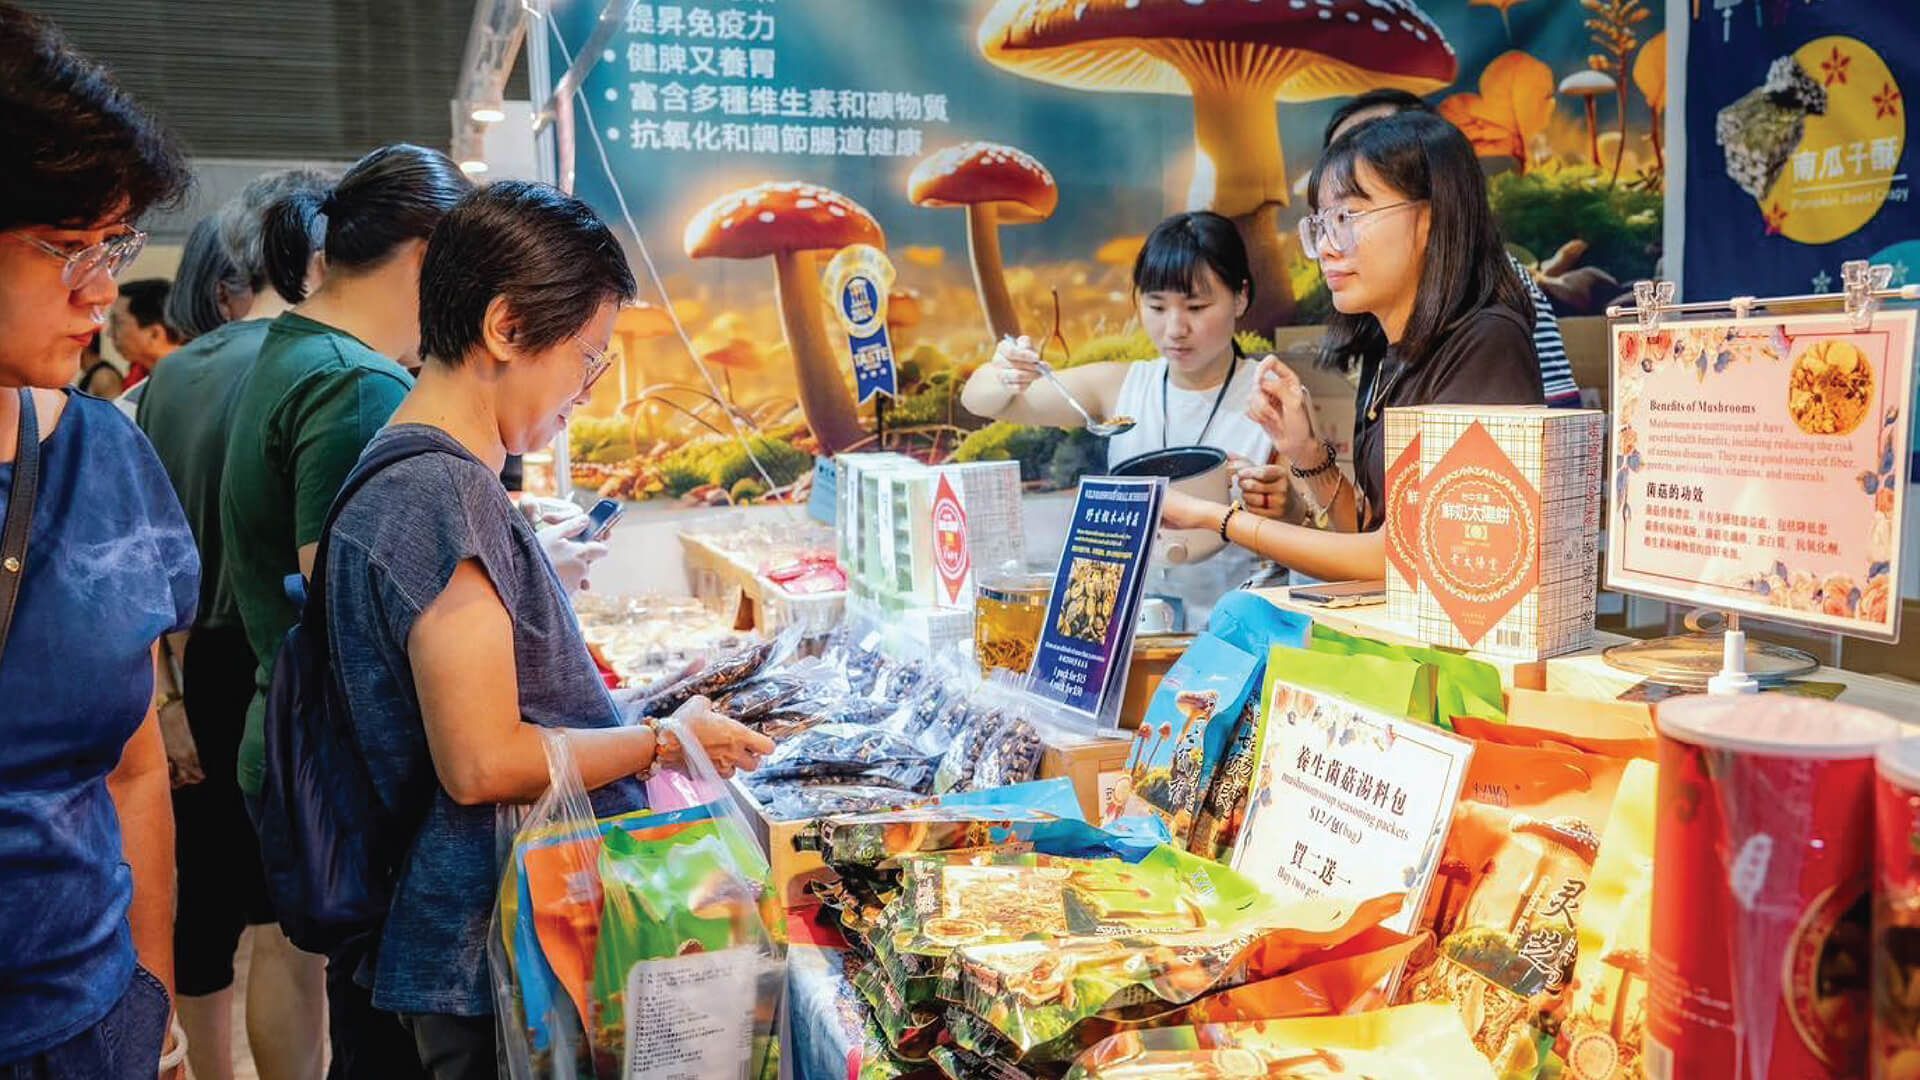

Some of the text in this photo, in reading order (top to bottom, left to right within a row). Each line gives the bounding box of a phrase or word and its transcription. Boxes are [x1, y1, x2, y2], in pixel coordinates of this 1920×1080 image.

[625, 4, 775, 40] 提昇免疫力
[626, 42, 775, 79] 健脾又養胃
[630, 118, 922, 156] 抗氧化和調節腸道健康
[1792, 136, 1898, 182] 南瓜子酥
[1650, 399, 1756, 413] Benefits of Mushrooms
[1646, 482, 1704, 503] 菌菇的功效
[1296, 743, 1408, 816] 養生菌菇湯料包
[1337, 800, 1377, 827] seasoning
[1375, 818, 1410, 841] packets
[1290, 840, 1352, 886] 買二送一
